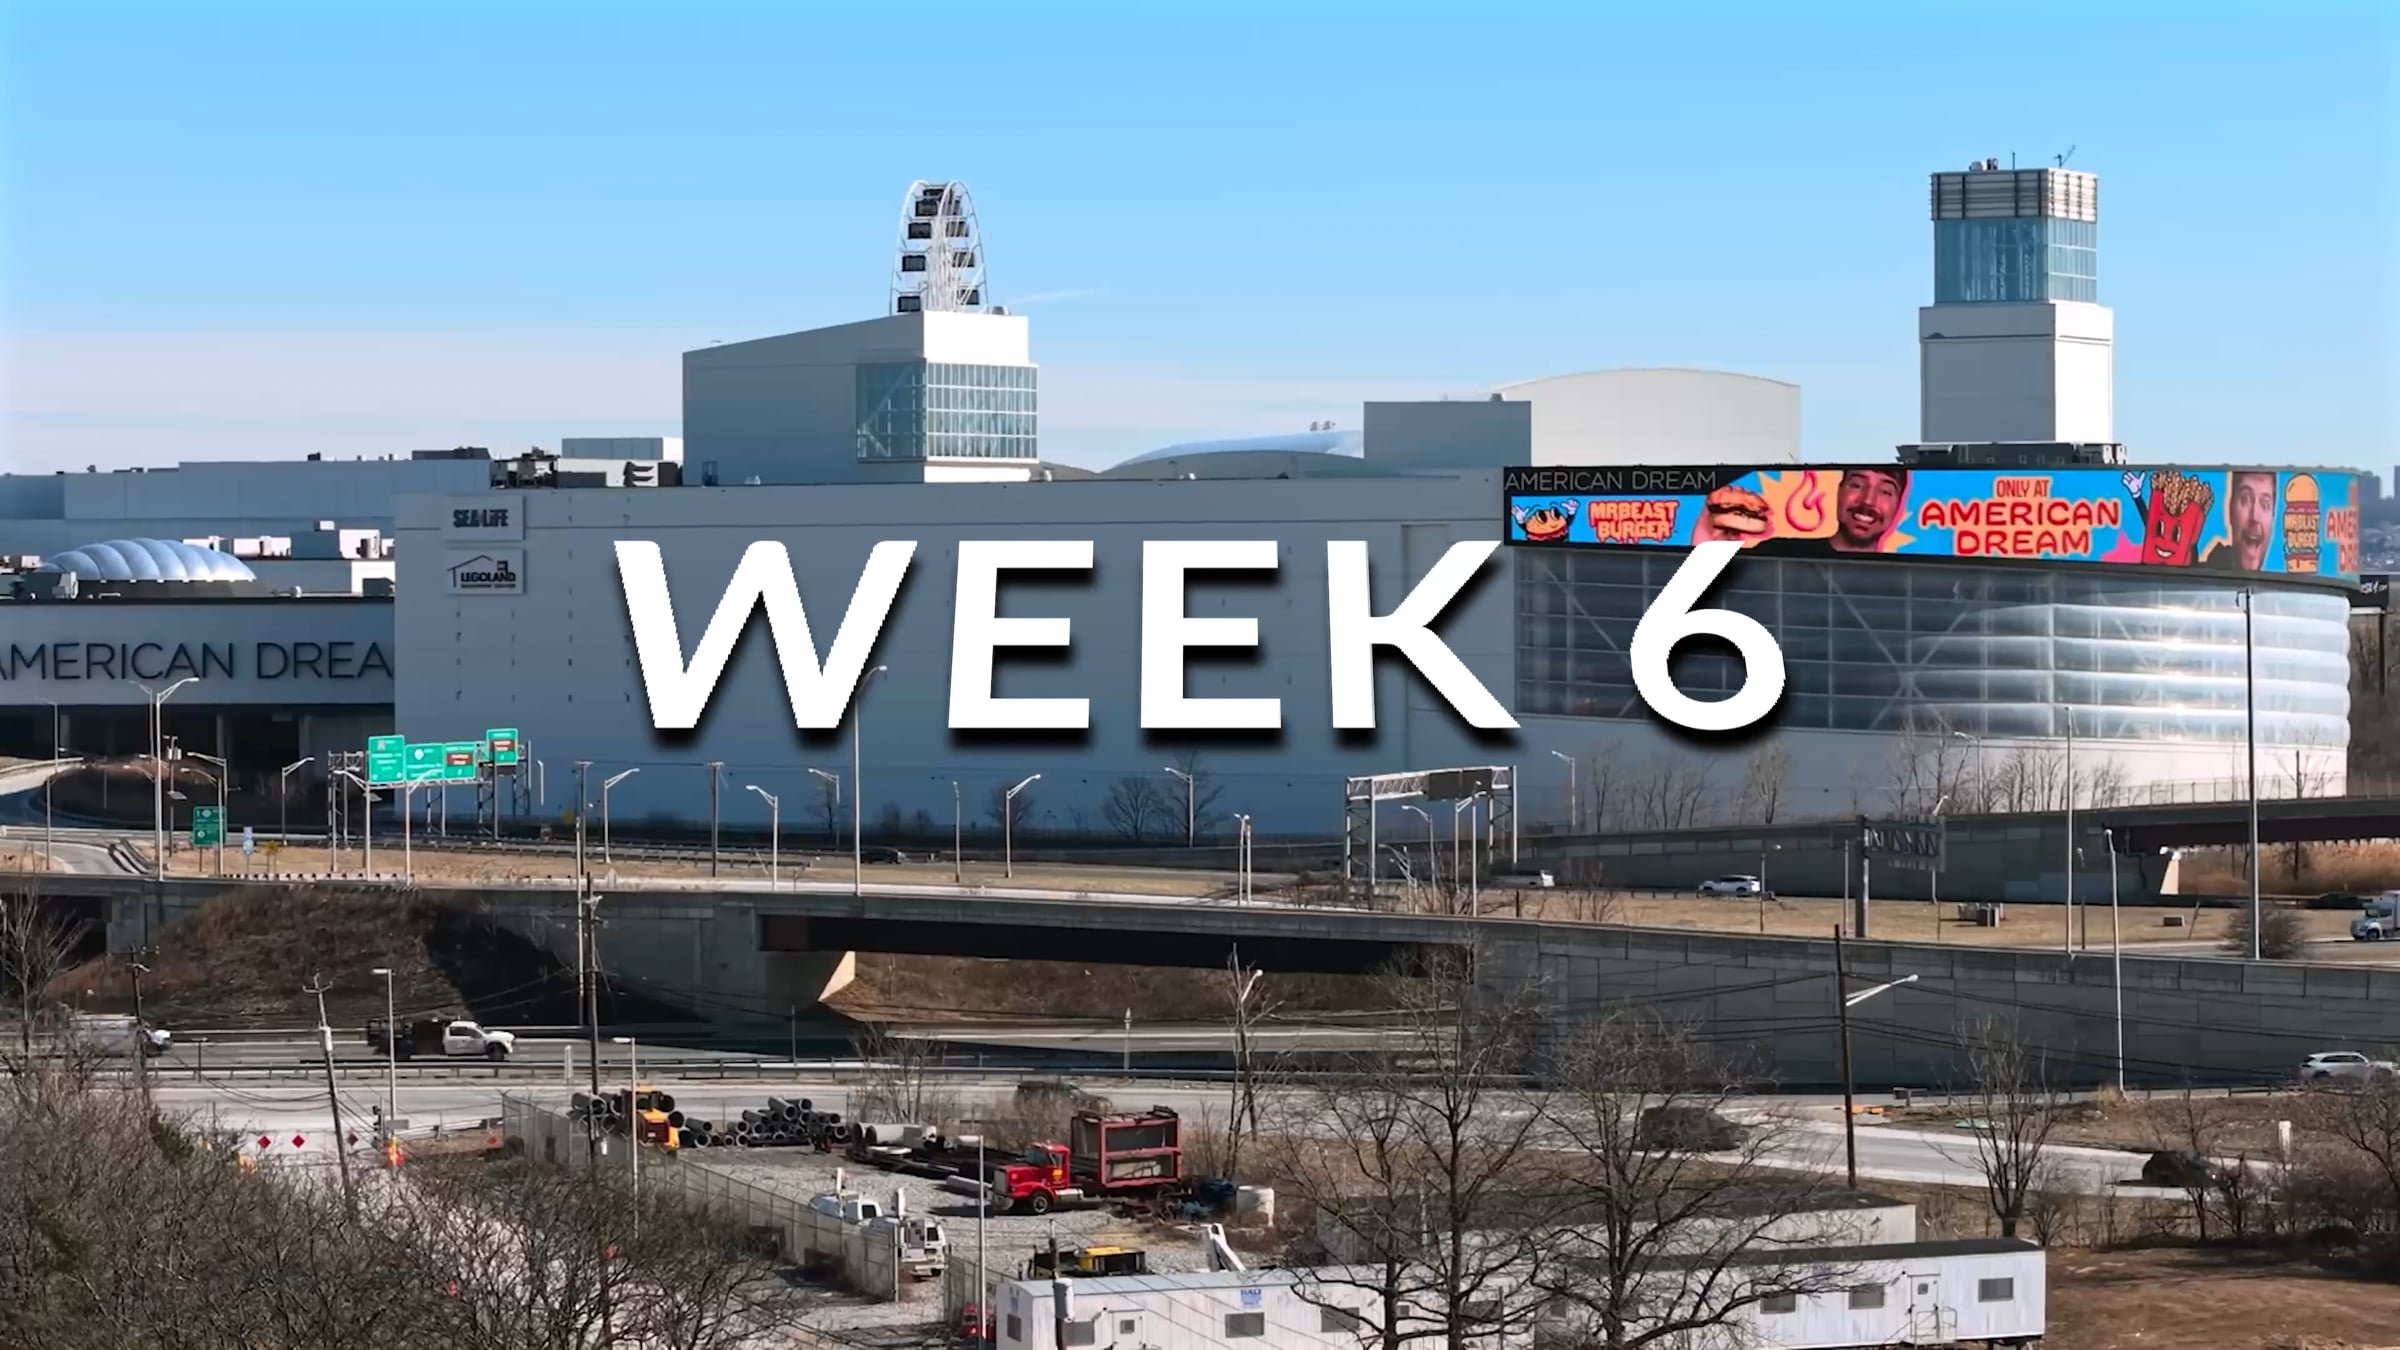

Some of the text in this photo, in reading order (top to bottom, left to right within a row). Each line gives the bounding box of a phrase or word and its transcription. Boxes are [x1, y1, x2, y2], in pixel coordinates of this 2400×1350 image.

[1504, 470, 1716, 491] AMERICAN DREAM
[1996, 479, 2050, 498] ONLY AT
[453, 509, 479, 528] SEA
[1589, 501, 1679, 522] MRBEAST
[1921, 501, 2119, 527] AMERICAN
[1597, 520, 1672, 541] BURGER
[1956, 530, 2090, 555] DREAM
[461, 572, 516, 583] LEGOLAND
[0, 642, 234, 680] MERICAN
